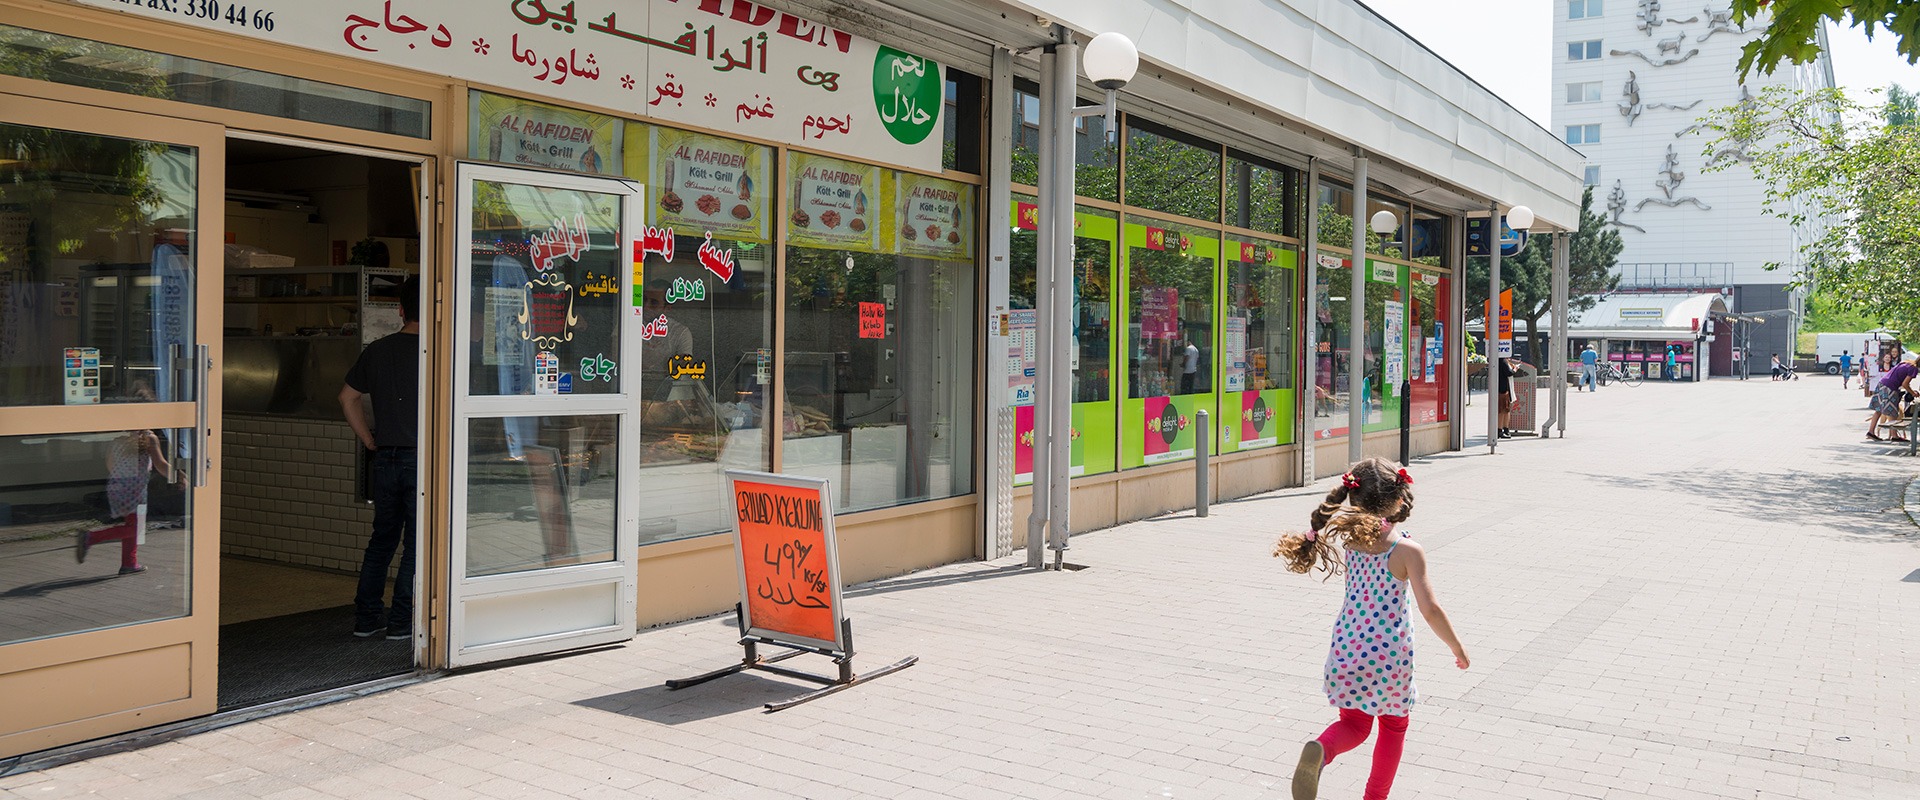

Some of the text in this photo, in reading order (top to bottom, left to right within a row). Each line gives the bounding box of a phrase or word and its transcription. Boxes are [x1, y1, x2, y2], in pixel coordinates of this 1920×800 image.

[184, 0, 219, 21] 330
[225, 3, 247, 27] 44
[253, 9, 275, 32] 66
[343, 0, 851, 141] لحوم غنم بقر شاورما دجاج
[881, 86, 931, 125] حلال
[500, 114, 594, 145] AL RAFIDEN
[520, 139, 540, 154] Kött
[549, 145, 574, 159] Grill
[674, 145, 747, 169] AL RAFIDEN
[689, 166, 707, 179] Kött
[714, 170, 734, 183] Grill
[802, 166, 863, 187] AL RAFIDEN
[816, 185, 831, 196] Kött
[836, 188, 851, 199] Grill
[911, 186, 959, 203] AL RAFIDEN
[919, 202, 934, 212] Kött
[937, 204, 950, 214] Grill
[1165, 233, 1180, 248] delight
[579, 271, 619, 298] ناقيش
[666, 277, 706, 304] فلافل
[580, 352, 618, 383] جاج
[668, 355, 707, 380] بيتزا
[1017, 389, 1029, 399] Ria
[1162, 415, 1178, 431] delight
[758, 576, 830, 609] حلال
